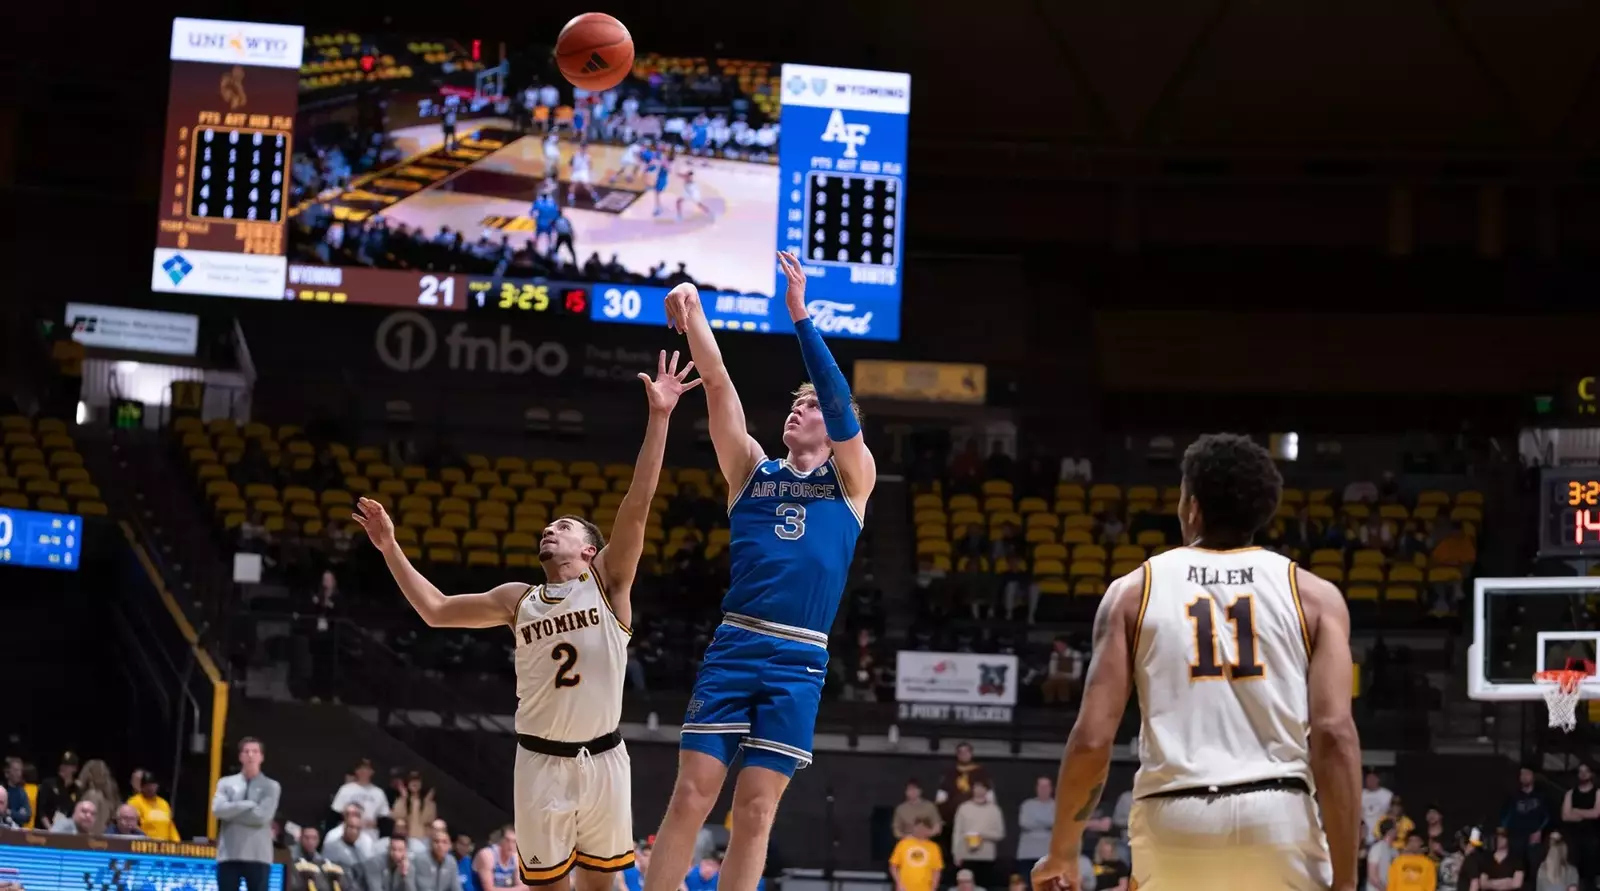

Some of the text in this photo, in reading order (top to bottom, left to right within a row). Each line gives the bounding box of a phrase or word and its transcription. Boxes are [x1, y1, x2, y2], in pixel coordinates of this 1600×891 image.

[418, 275, 455, 307] 21
[475, 292, 485, 308] 1
[499, 282, 549, 311] 3:25
[565, 290, 586, 313] 15
[603, 288, 642, 319] 30
[807, 300, 873, 335] Ford
[445, 322, 569, 377] fnbo
[751, 481, 836, 501] AIR FORCE
[1568, 480, 1600, 505] 3:2
[775, 503, 806, 540] 3
[1187, 565, 1254, 586] ALLEN
[521, 607, 600, 645] WYOMING
[1185, 593, 1266, 681] 11
[552, 642, 581, 688] 2
